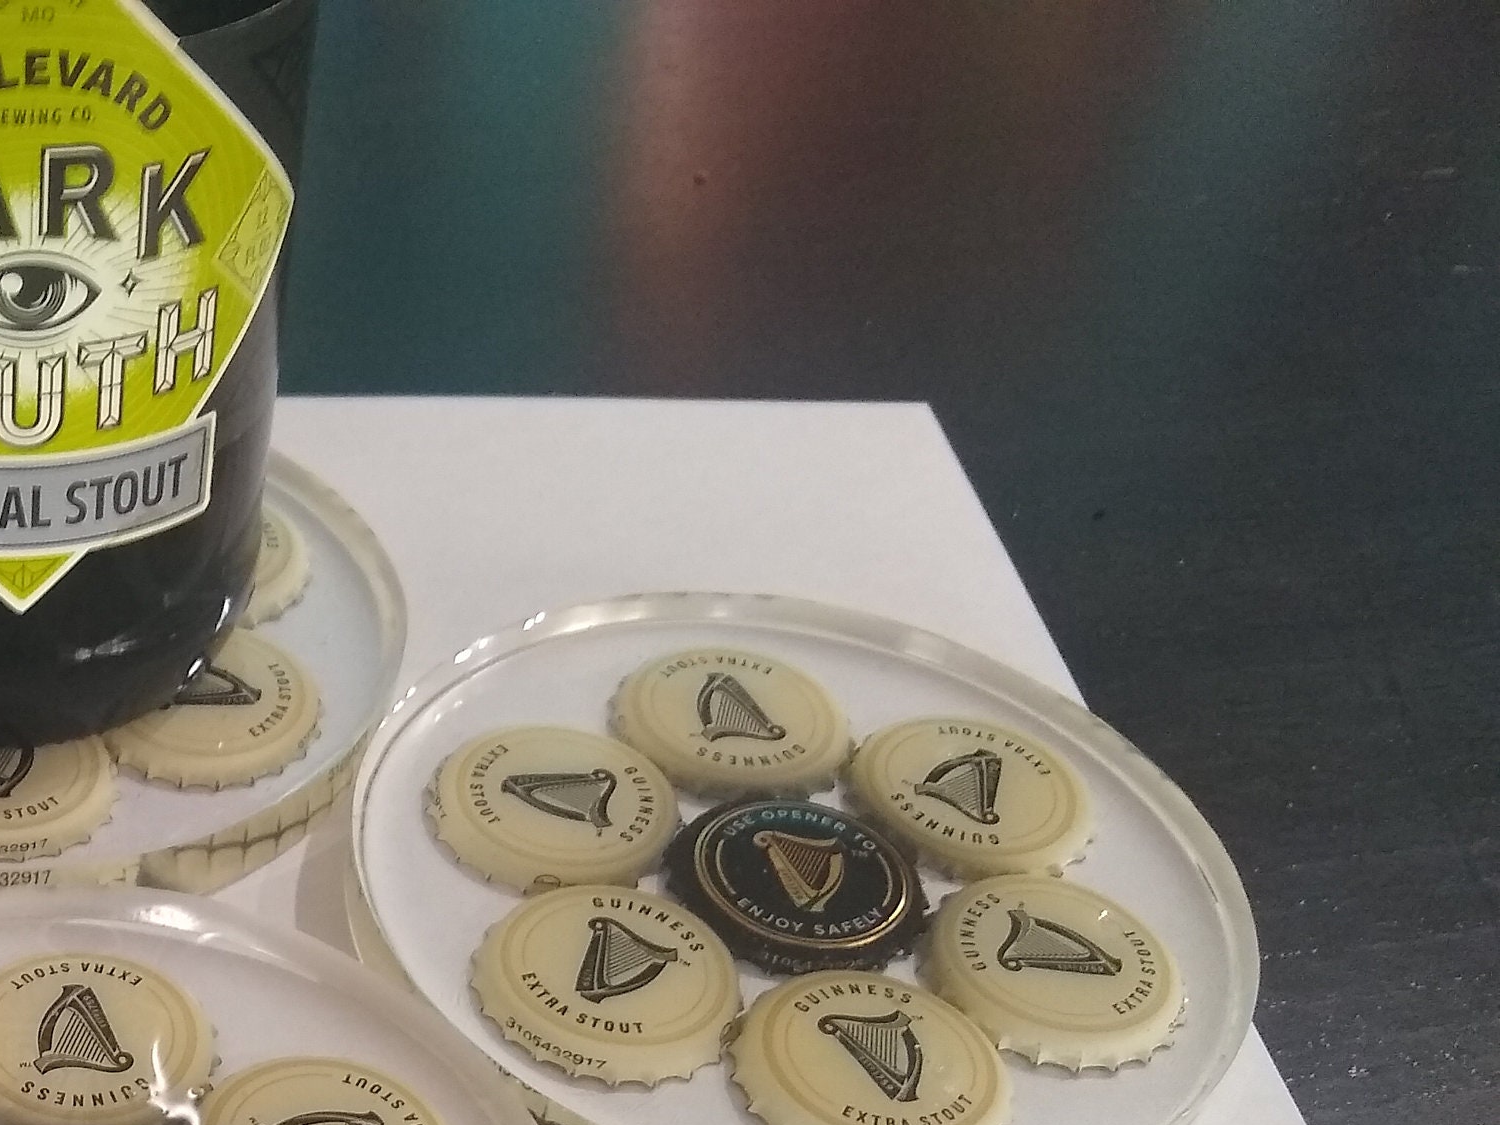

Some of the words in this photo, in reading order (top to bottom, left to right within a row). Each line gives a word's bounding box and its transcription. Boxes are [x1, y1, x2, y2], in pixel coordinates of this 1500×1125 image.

[66, 453, 189, 522] STOUT
[268, 662, 292, 701] STOUT
[249, 703, 289, 738] EXTRA
[938, 726, 997, 742] STOUT
[471, 744, 509, 778] EXTRA
[697, 743, 806, 766] GUINNESS
[1004, 739, 1051, 775] EXTRA
[4, 797, 59, 820] STOUT
[470, 783, 500, 824] STOUT
[620, 766, 654, 842] GUINNESS
[891, 792, 999, 845] GUINNESS
[722, 816, 756, 837] USE
[761, 810, 847, 832] OPENER
[854, 832, 877, 850] TO
[592, 897, 704, 952] GUINNESS
[737, 897, 804, 933] ENJOY
[814, 907, 883, 936] SAFELY
[959, 893, 1000, 971] GUINNESS
[1123, 930, 1156, 976] STOUT
[10, 962, 70, 990] STOUT
[81, 962, 143, 986] EXTRA
[521, 971, 569, 1016] EXTRA
[576, 1012, 643, 1034] STOUT
[794, 983, 912, 1012] GUINNESS
[1112, 979, 1153, 1015] EXTRA
[505, 1016, 607, 1068] 3105432917
[342, 1074, 405, 1110] STOUT
